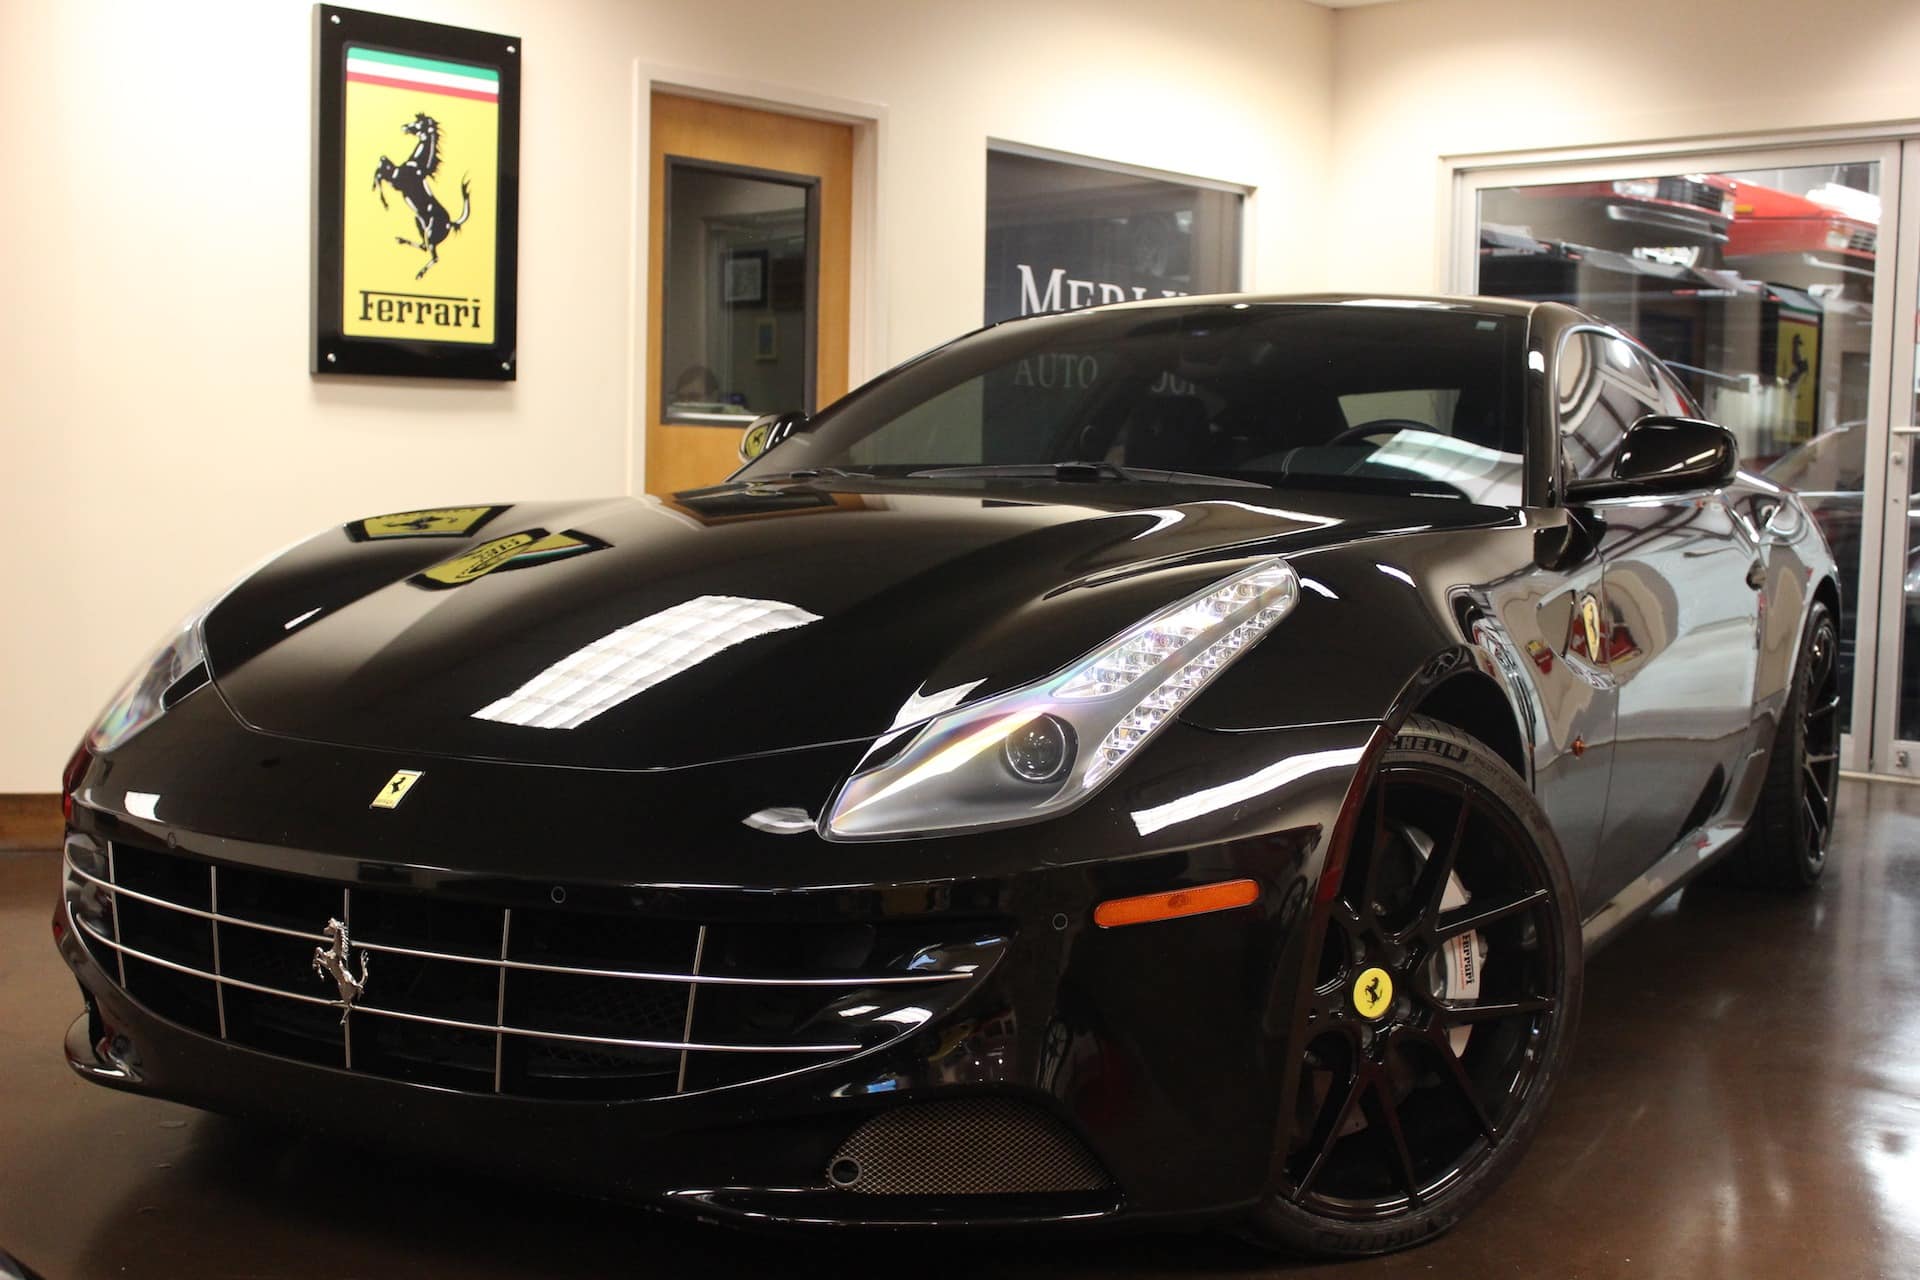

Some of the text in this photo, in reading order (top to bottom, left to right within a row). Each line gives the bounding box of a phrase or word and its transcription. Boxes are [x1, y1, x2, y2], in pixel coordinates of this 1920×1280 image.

[359, 290, 480, 328] Ferrari
[1014, 353, 1098, 388] AUTO
[1463, 933, 1475, 985] Ferrari
